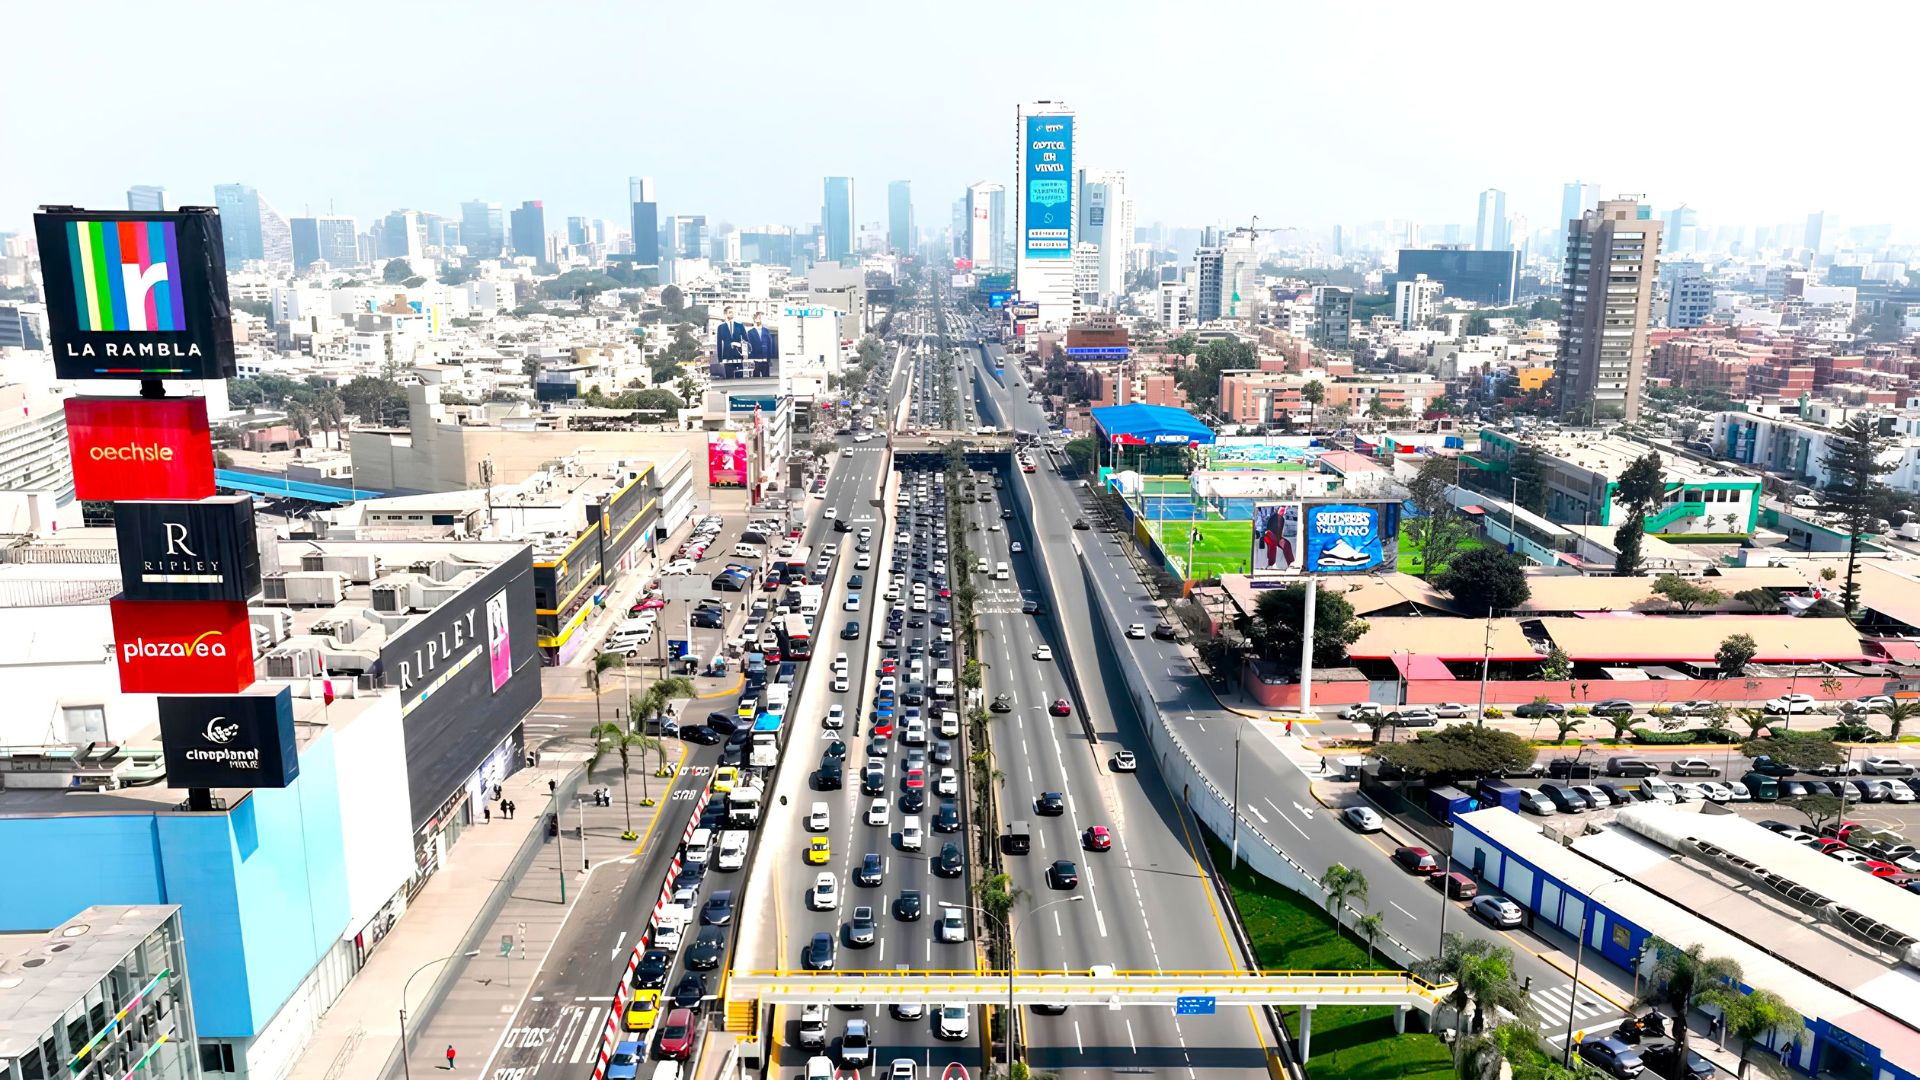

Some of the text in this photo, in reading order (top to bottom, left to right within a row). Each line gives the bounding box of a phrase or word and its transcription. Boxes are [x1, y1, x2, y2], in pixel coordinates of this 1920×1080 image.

[67, 342, 202, 357] LA RAMBLA
[90, 442, 173, 461] oechsle
[163, 522, 197, 557] R
[144, 561, 219, 571] RIPLEY
[124, 631, 226, 663] plazavea
[398, 608, 476, 691] RIPLEY
